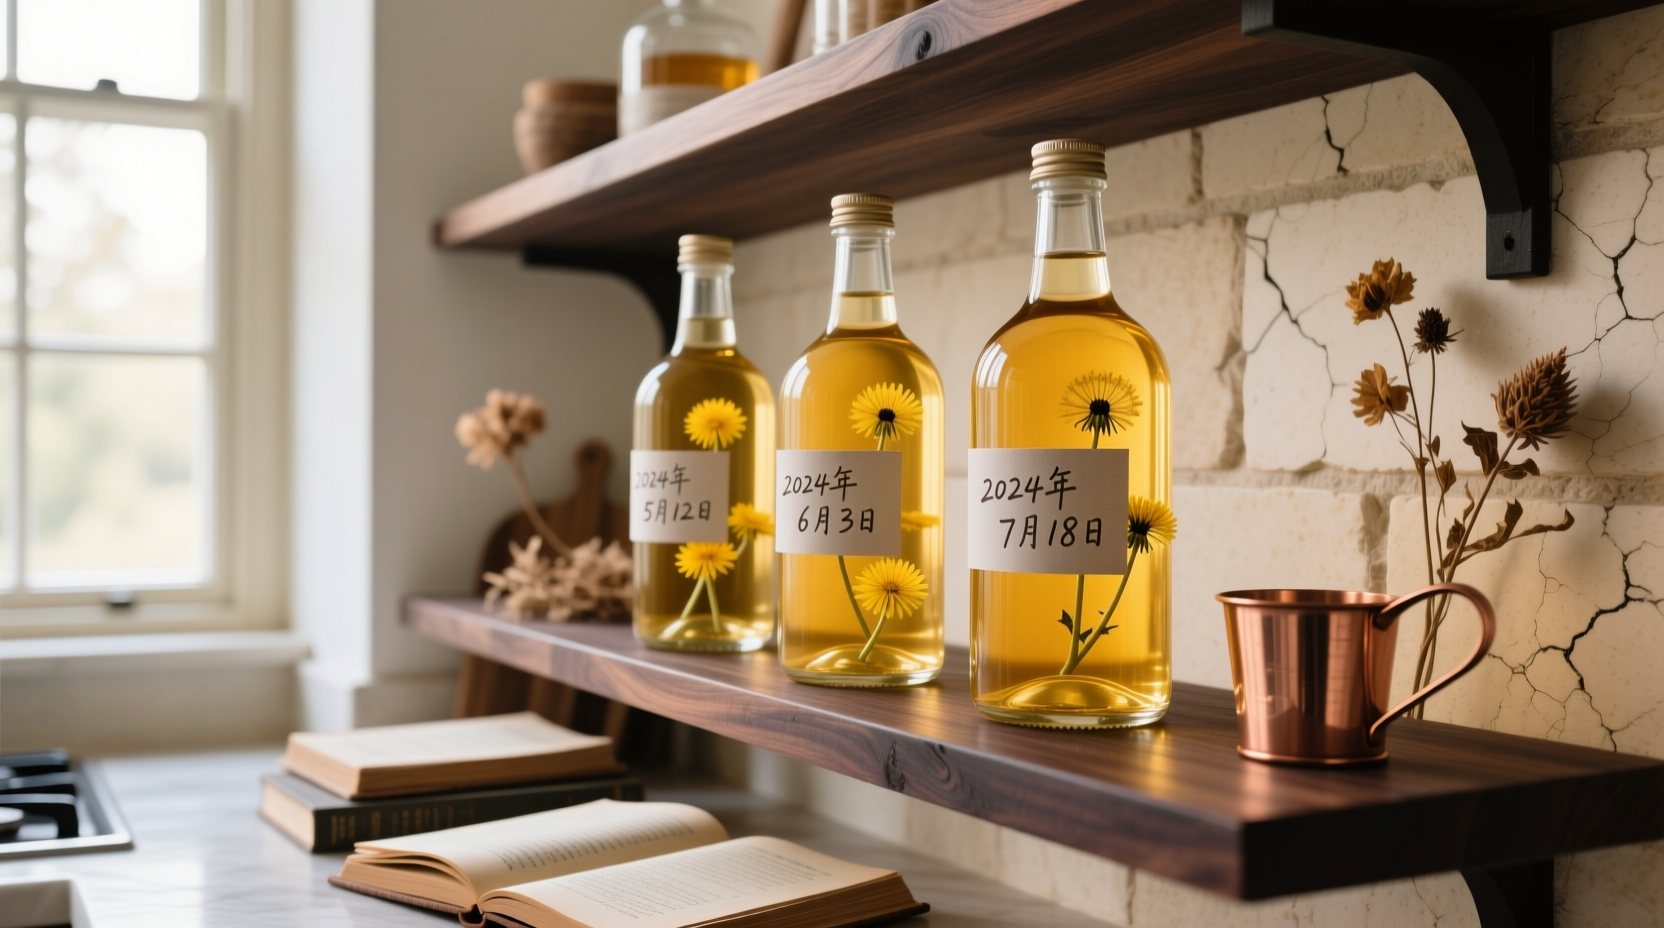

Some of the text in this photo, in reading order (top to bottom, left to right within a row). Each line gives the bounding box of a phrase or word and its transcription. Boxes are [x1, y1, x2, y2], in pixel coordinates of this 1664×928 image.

[635, 463, 691, 495] 2024年
[781, 466, 857, 502] 2024年
[980, 466, 1077, 511] 2024年
[643, 499, 711, 525] 5月12日
[797, 505, 875, 536] 6月3日
[998, 514, 1103, 550] 7月18日
